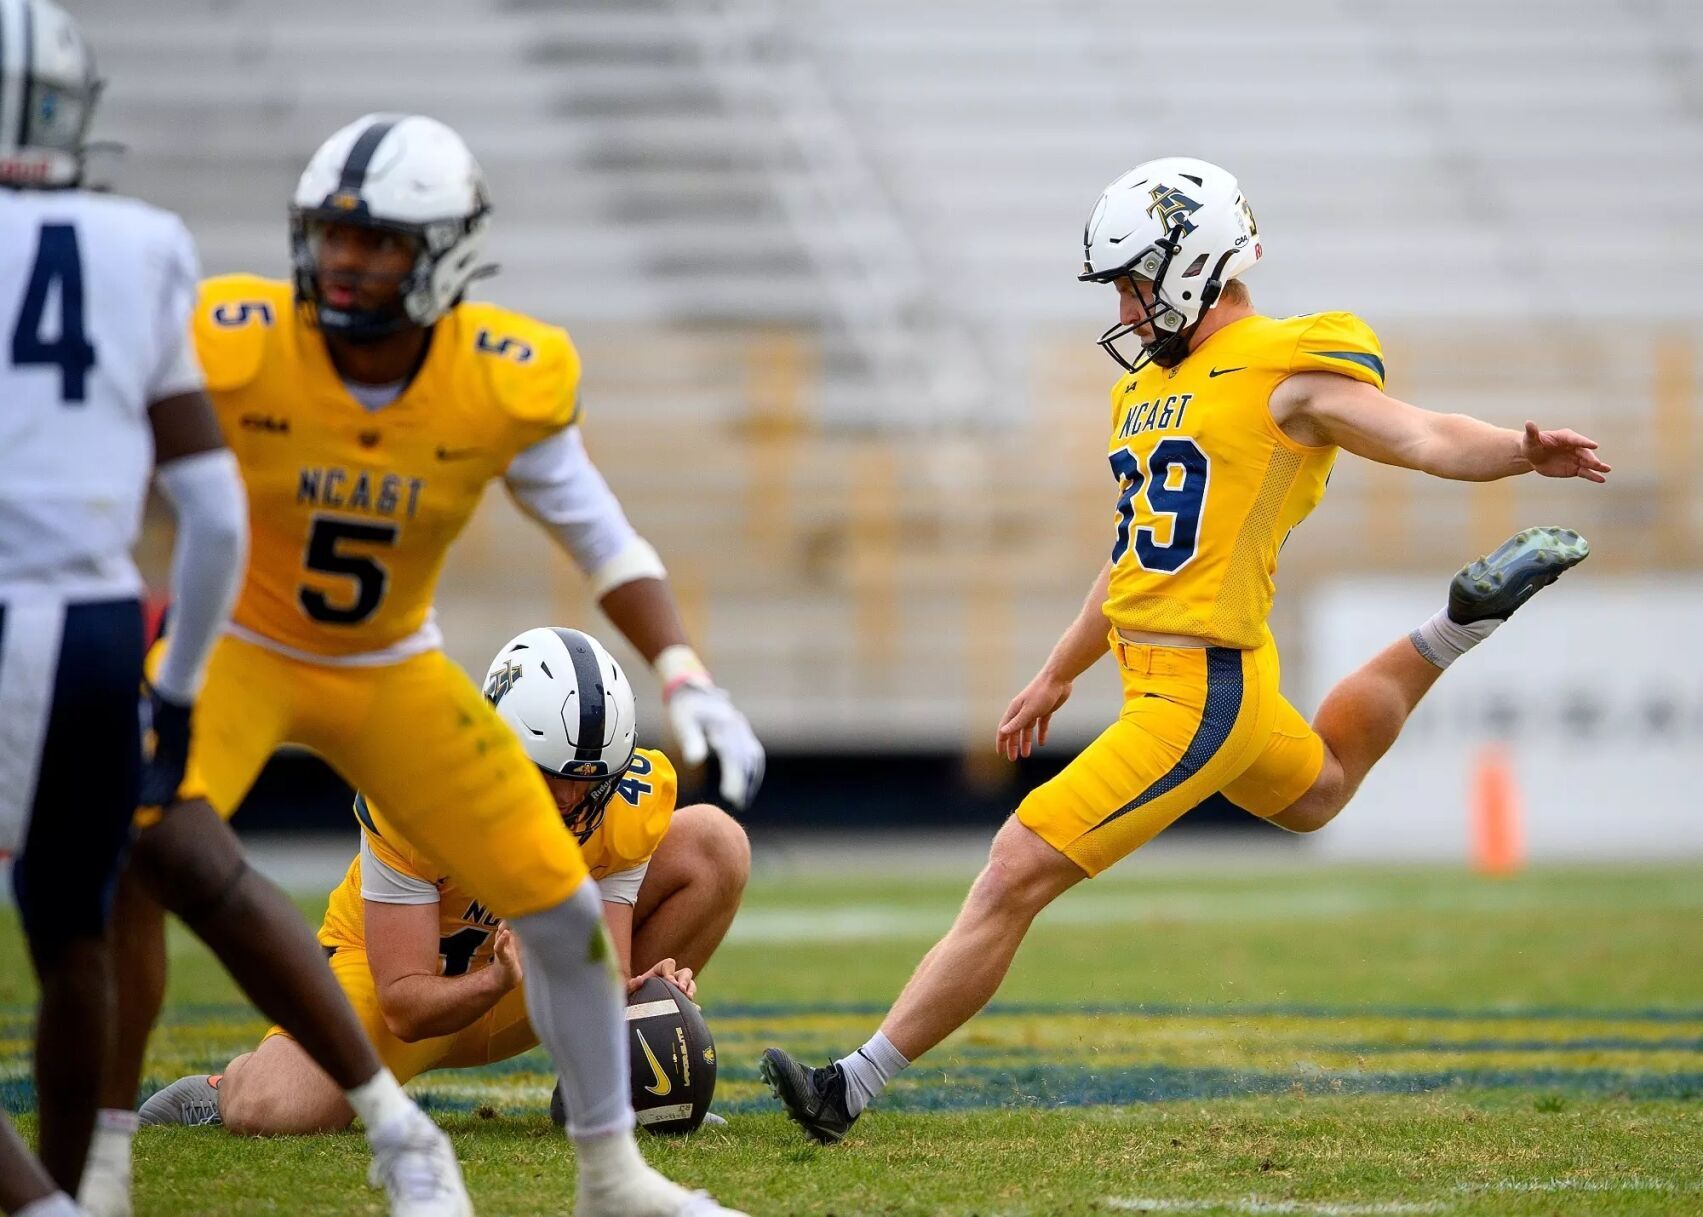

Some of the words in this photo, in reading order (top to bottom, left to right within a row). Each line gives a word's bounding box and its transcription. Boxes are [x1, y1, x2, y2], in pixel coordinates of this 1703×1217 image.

[11, 222, 96, 402] 4
[214, 303, 274, 325] 5
[475, 329, 532, 362] 5
[1118, 393, 1193, 439] NCA&T
[298, 466, 425, 519] NCA&T
[1108, 436, 1210, 575] 39
[298, 513, 398, 626] 5
[616, 753, 652, 807] 40
